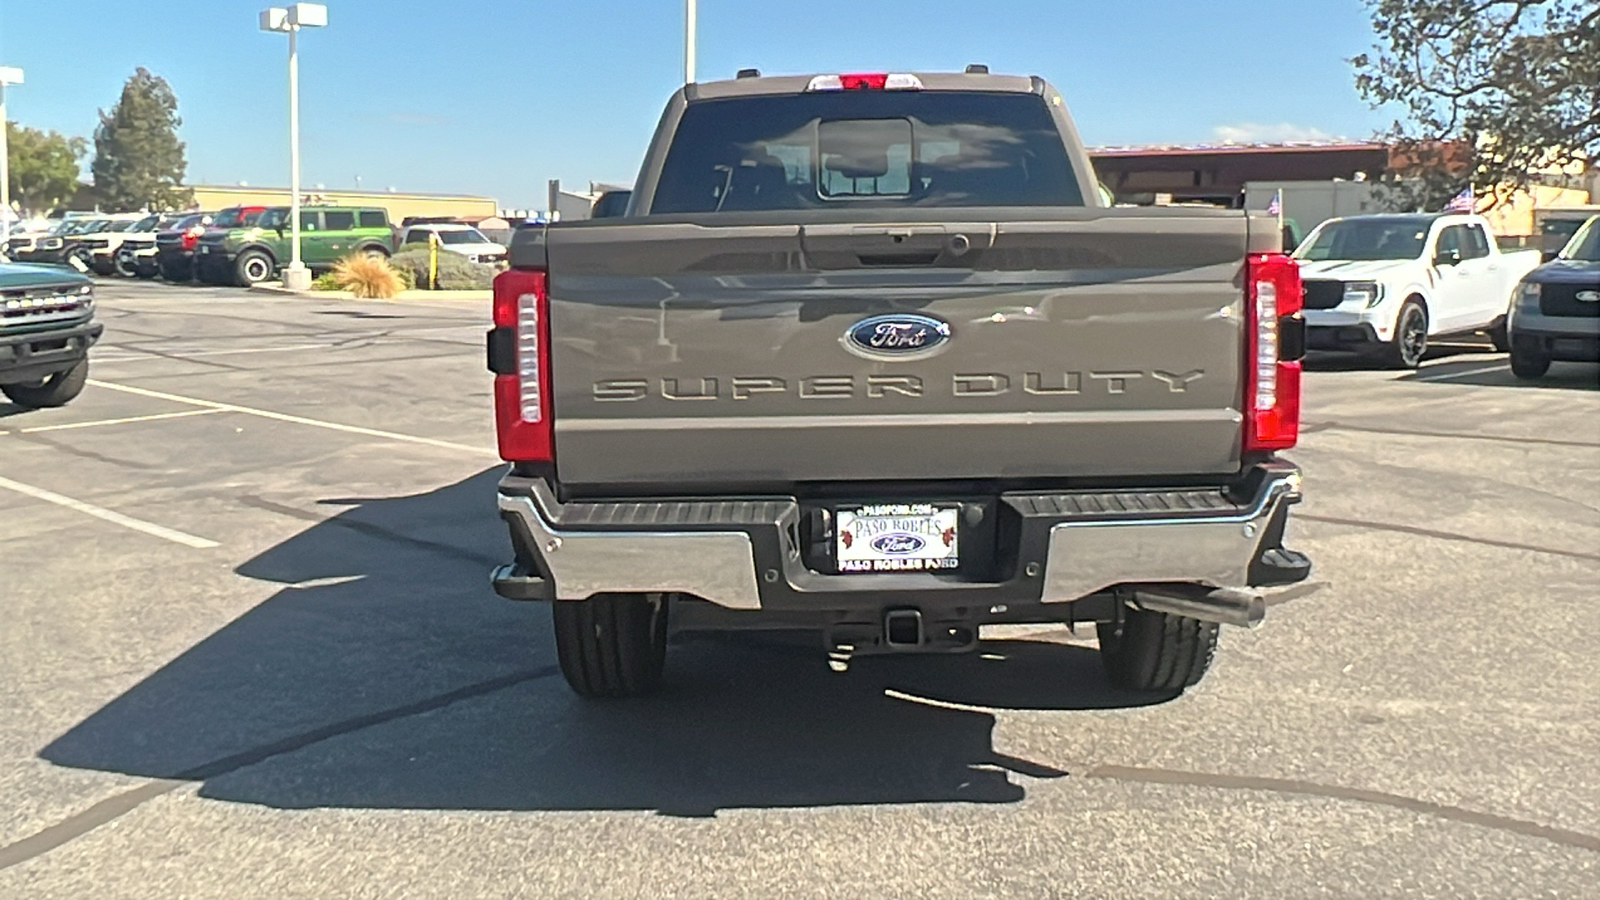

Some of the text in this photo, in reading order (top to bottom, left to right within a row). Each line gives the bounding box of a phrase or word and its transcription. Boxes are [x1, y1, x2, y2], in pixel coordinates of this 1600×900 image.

[870, 323, 926, 347] Ford
[593, 369, 1204, 401] SUPER DUTY
[855, 518, 942, 539] PASO ROBLES
[881, 536, 916, 552] Ford
[838, 559, 873, 571] PASO
[874, 559, 923, 571] ROBLES
